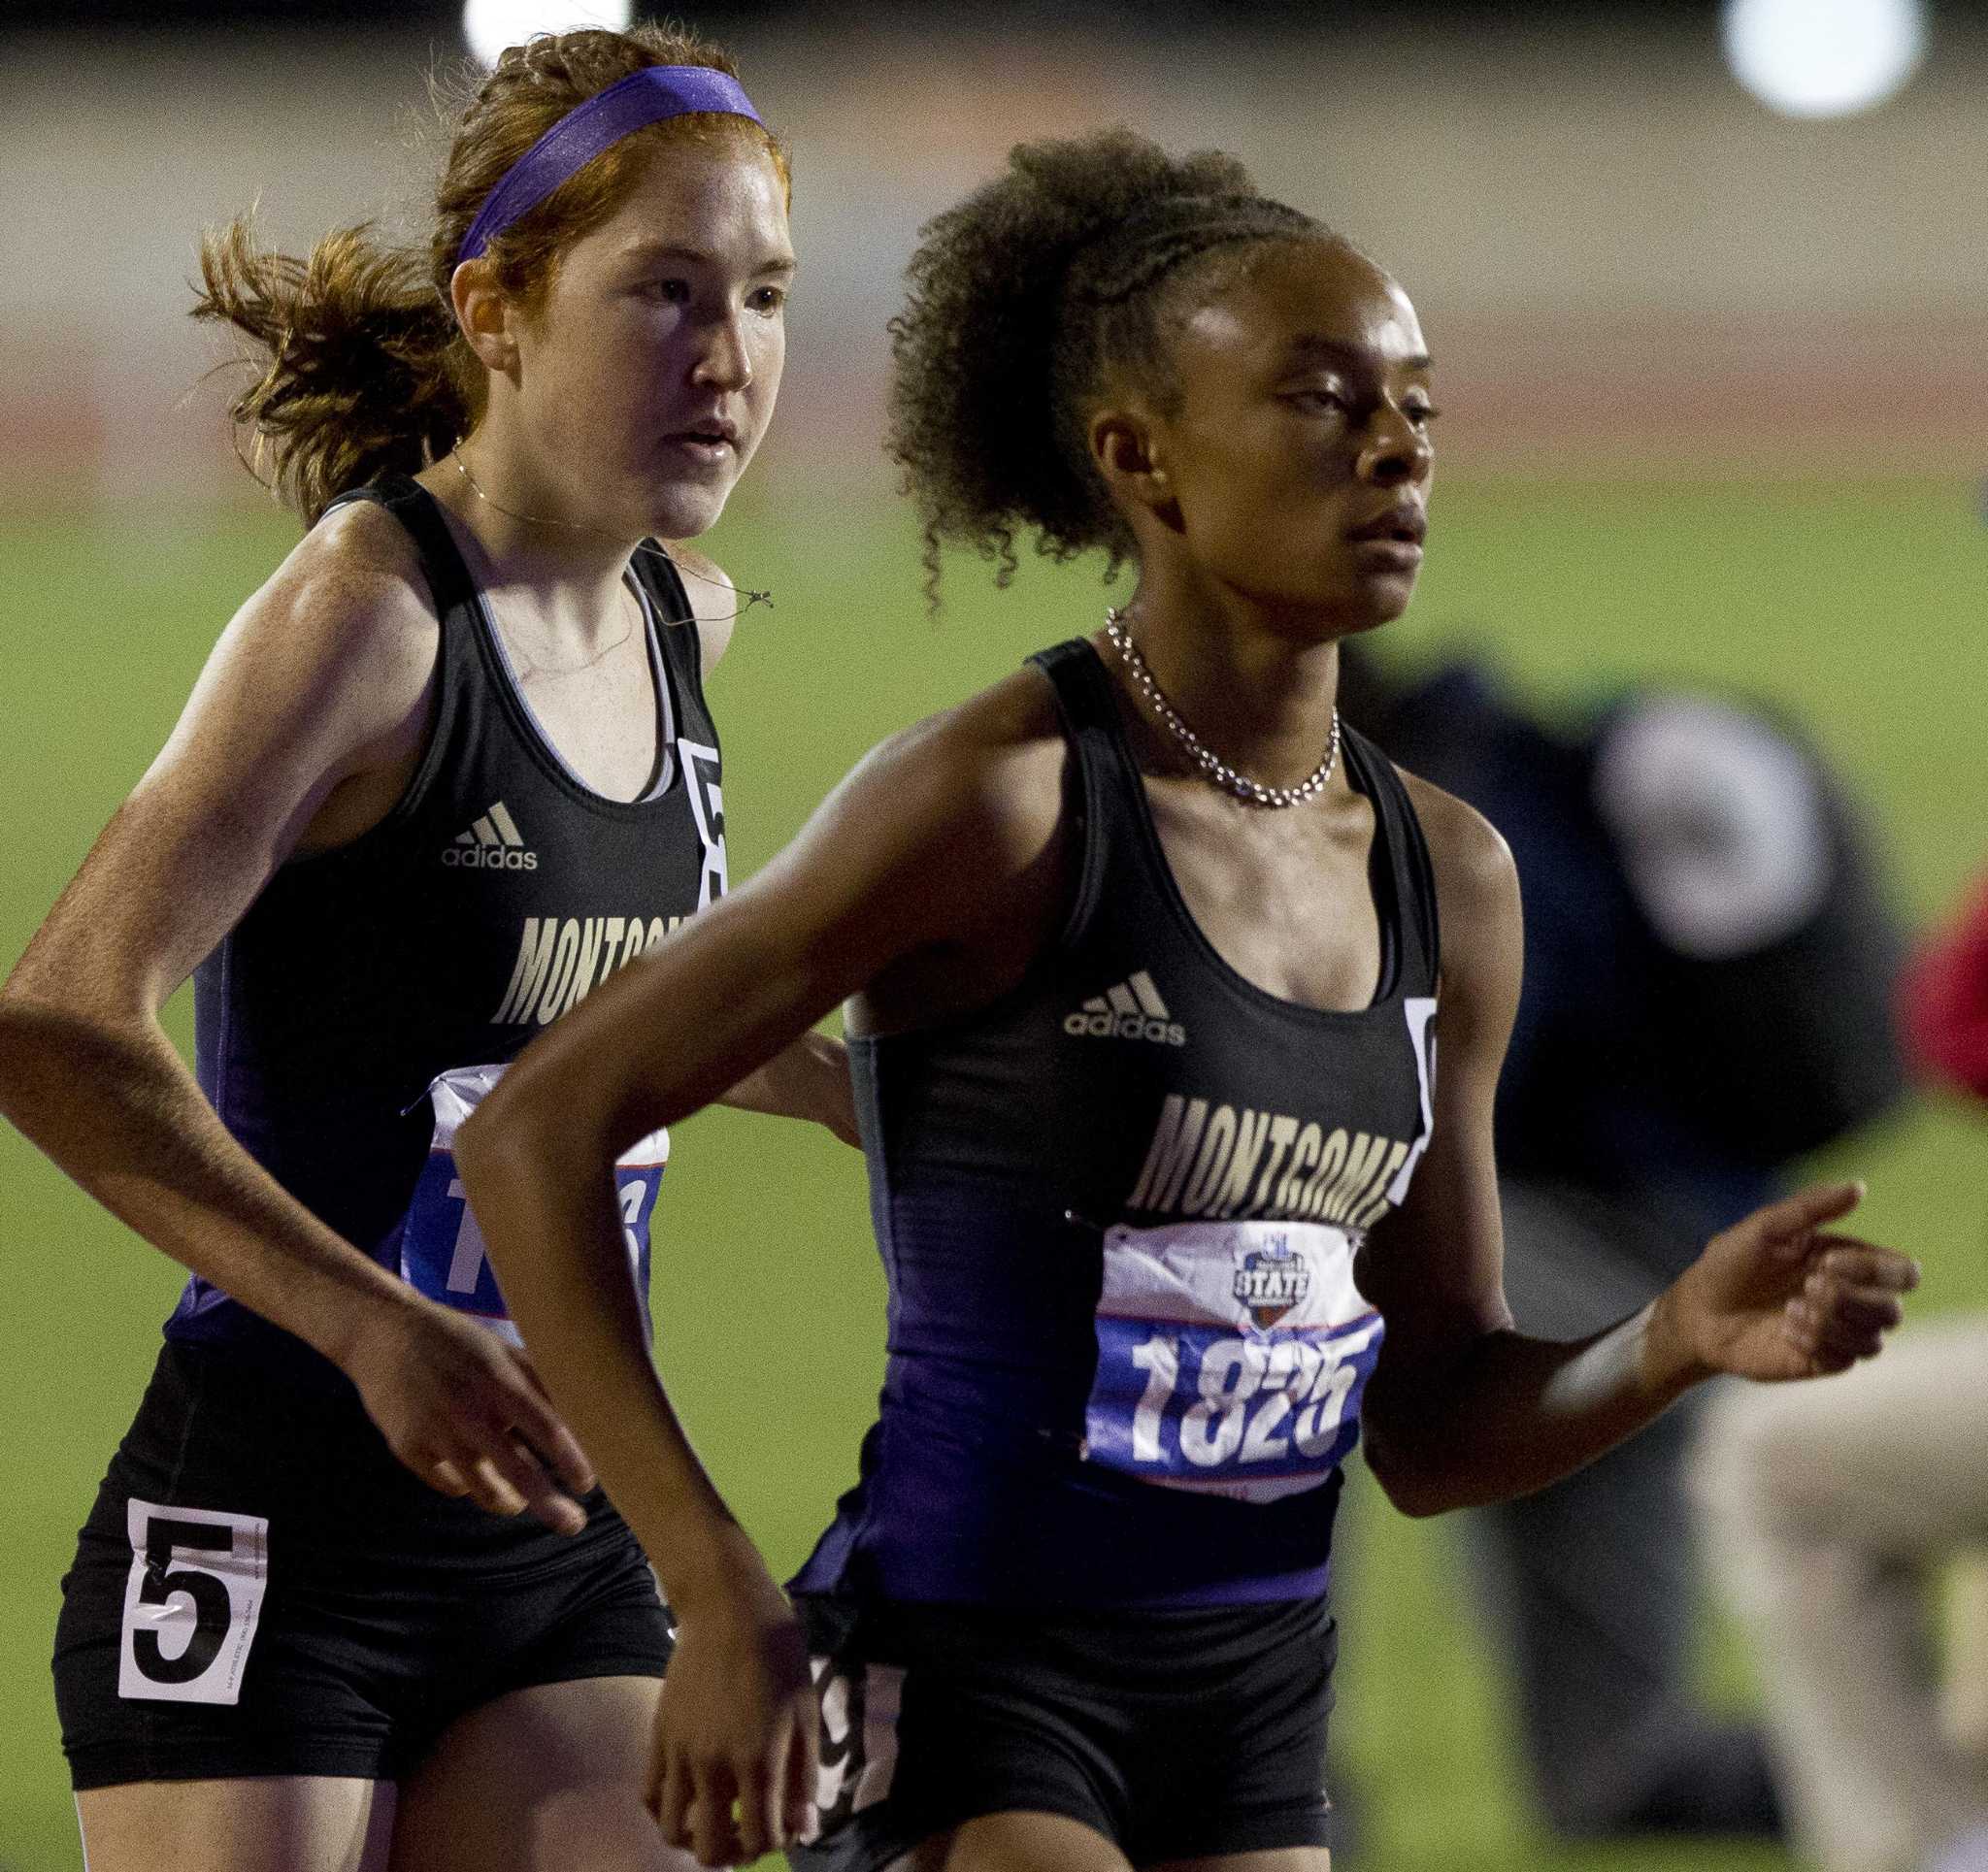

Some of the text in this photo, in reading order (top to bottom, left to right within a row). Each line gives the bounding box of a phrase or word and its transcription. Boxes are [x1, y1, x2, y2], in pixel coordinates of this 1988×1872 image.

[442, 842, 538, 870] adidas
[489, 917, 695, 1025] MONT
[1064, 1011, 1186, 1047] adidas
[1234, 1269, 1309, 1298] STATE
[1132, 1328, 1372, 1467] 1825
[132, 1516, 233, 1685] 5
